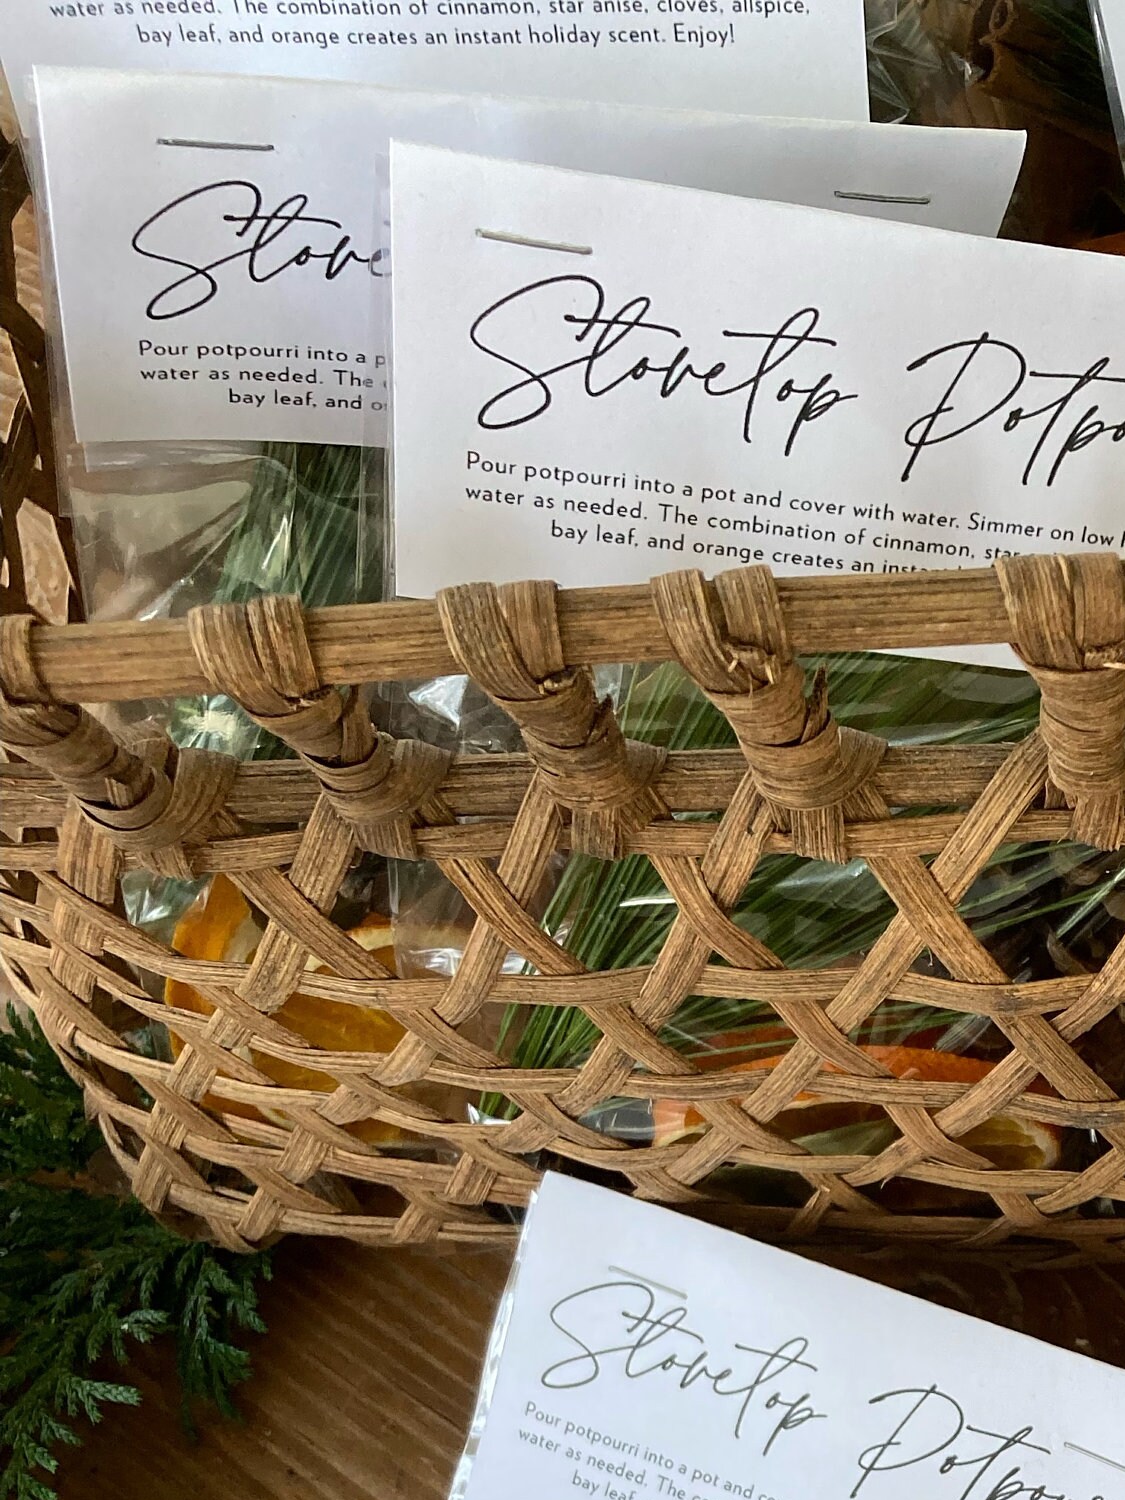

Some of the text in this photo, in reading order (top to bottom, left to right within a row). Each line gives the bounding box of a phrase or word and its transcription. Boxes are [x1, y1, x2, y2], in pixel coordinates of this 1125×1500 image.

[135, 21, 735, 50] bay leaf, and orange creates an instant holiday scent. Enjoy!
[138, 339, 349, 363] Pour potpourri into
[469, 274, 859, 456] Stovetop
[465, 487, 976, 561] water as needed. The combination of cinnamon,
[466, 450, 1115, 549] Pour potpourri into a pot and cover with water. Simmer on low
[541, 1281, 828, 1456] Stovetop
[519, 1429, 561, 1452] water
[565, 1447, 582, 1461] as
[586, 1455, 648, 1487] needed.
[657, 1474, 686, 1500] The
[524, 1401, 562, 1427] Pour
[563, 1421, 639, 1457] potpourri
[643, 1450, 674, 1470] into
[678, 1463, 688, 1475] a
[690, 1468, 719, 1487] pot
[723, 1480, 755, 1500] and
[571, 1469, 600, 1496] bay
